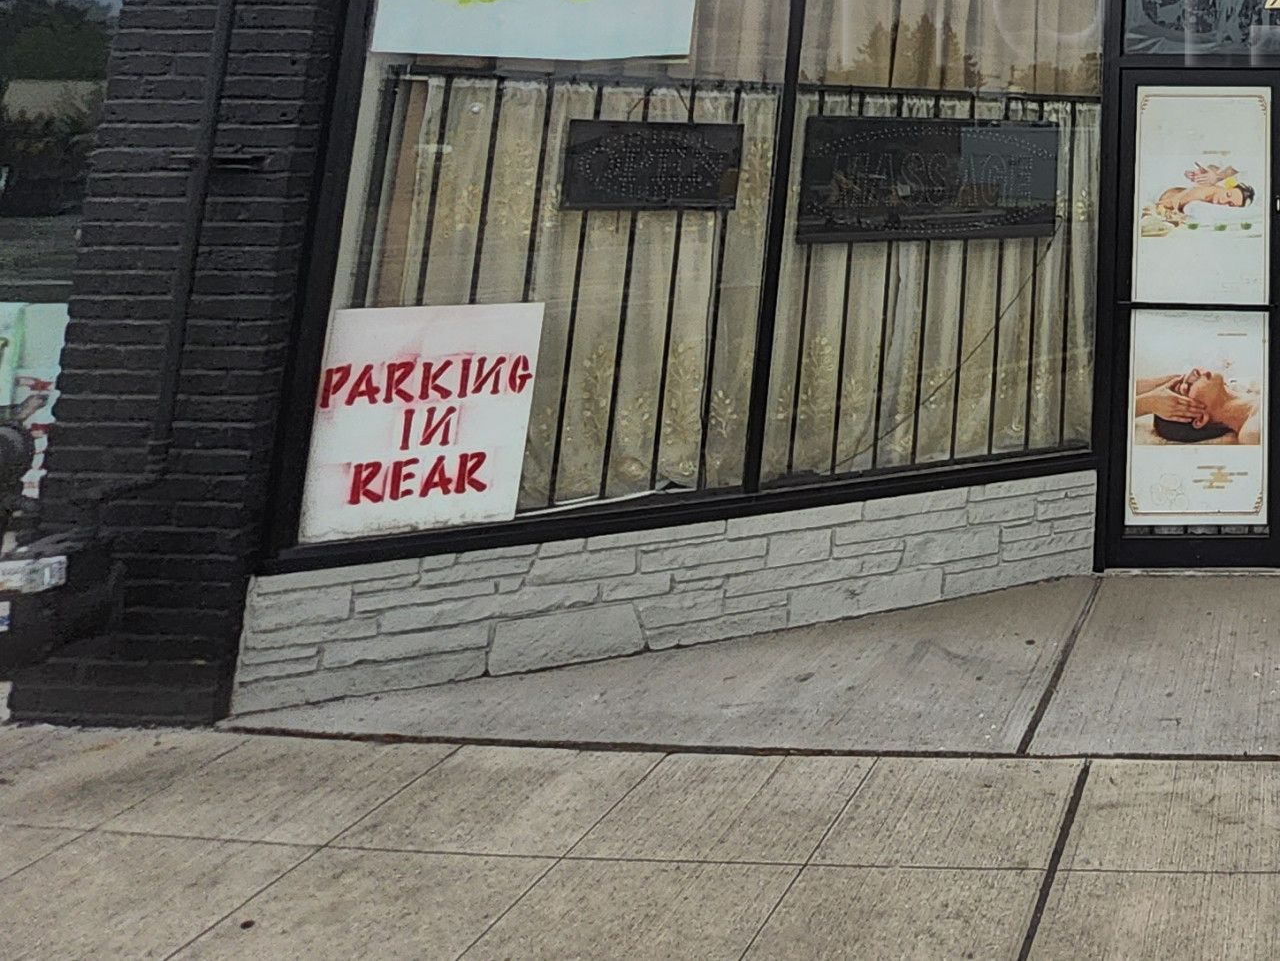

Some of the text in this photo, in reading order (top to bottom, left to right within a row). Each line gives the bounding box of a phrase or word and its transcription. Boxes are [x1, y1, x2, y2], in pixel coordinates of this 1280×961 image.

[319, 354, 534, 409] PARKING
[399, 405, 457, 451] IN
[347, 451, 488, 506] REAR
